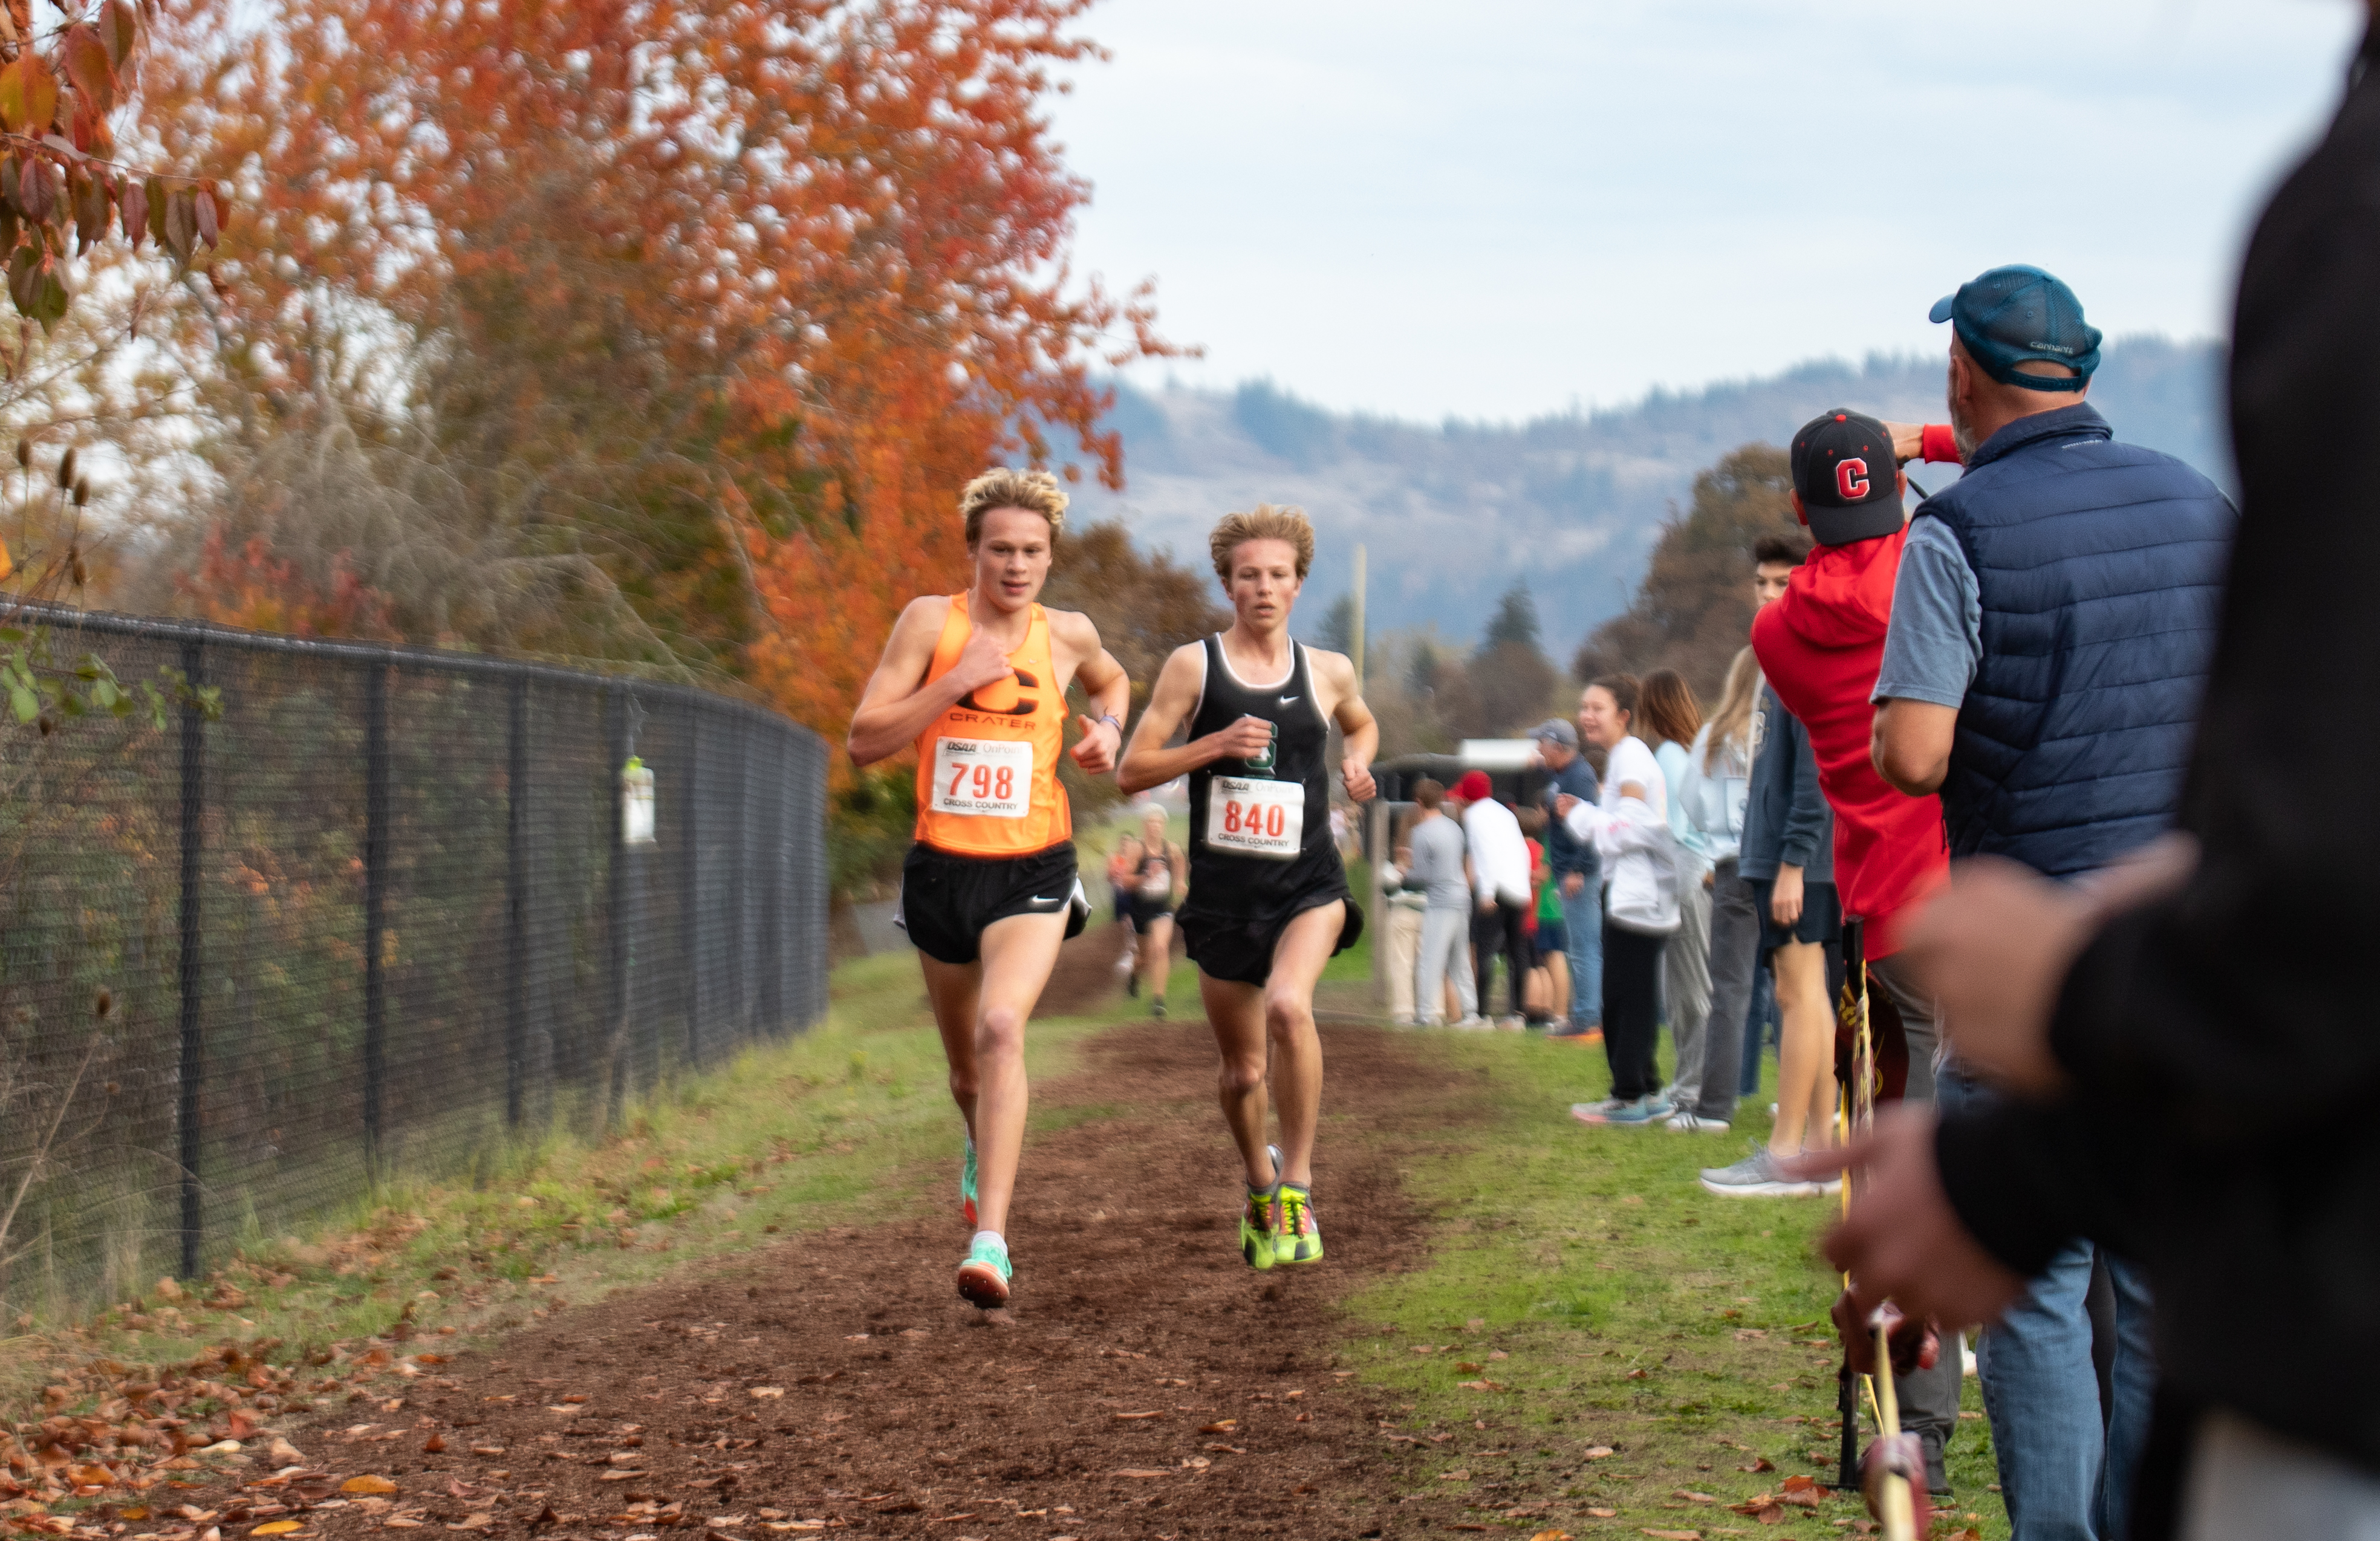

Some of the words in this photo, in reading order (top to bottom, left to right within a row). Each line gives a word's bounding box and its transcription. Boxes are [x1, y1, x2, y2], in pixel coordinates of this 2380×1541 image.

[1836, 457, 1870, 499] C
[950, 713, 1036, 730] CRATER
[946, 741, 977, 753] OSAA
[983, 742, 1023, 754] OnPoint
[949, 762, 1014, 800] 798
[943, 797, 973, 808] CROSS
[975, 801, 1018, 810] COUNTRY
[1224, 799, 1285, 837] 840
[1218, 832, 1246, 843] CROSS
[1247, 837, 1290, 847] COUNTRY
